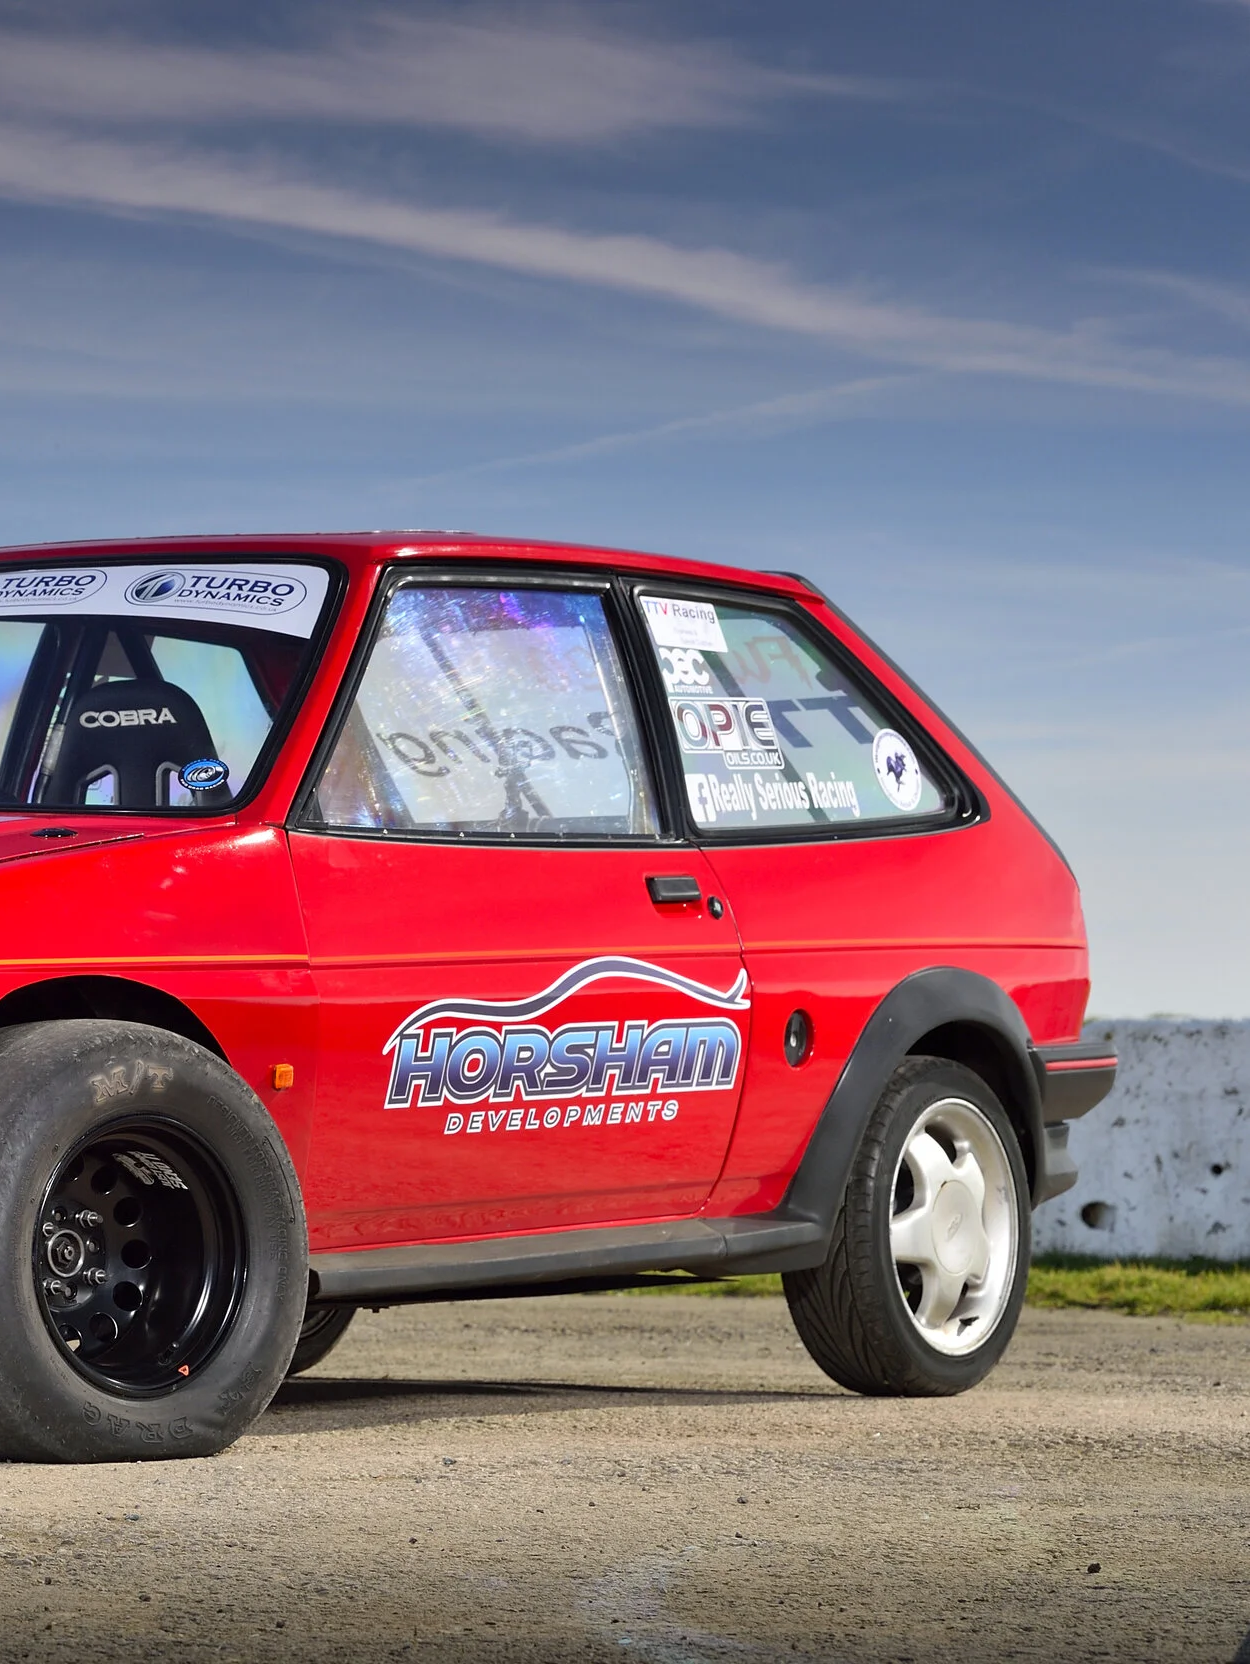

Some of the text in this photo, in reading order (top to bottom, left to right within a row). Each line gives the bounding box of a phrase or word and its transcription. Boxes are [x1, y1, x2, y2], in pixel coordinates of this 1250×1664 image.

[2, 574, 97, 590] TURBO
[189, 575, 295, 596] TURBO
[177, 589, 284, 606] DYNAMICS
[643, 600, 715, 624] TTV Racing
[79, 707, 178, 728] COBRA
[676, 700, 776, 750] OPIE
[726, 752, 782, 766] OILS.CO.UK
[708, 774, 757, 820] Really
[753, 772, 811, 811] Serious
[805, 771, 860, 817] Racing
[384, 1016, 742, 1109] HORSHAM
[88, 1059, 175, 1103] M/T
[444, 1100, 679, 1134] DEVELOPMENTS
[82, 1400, 194, 1444] DRAG
